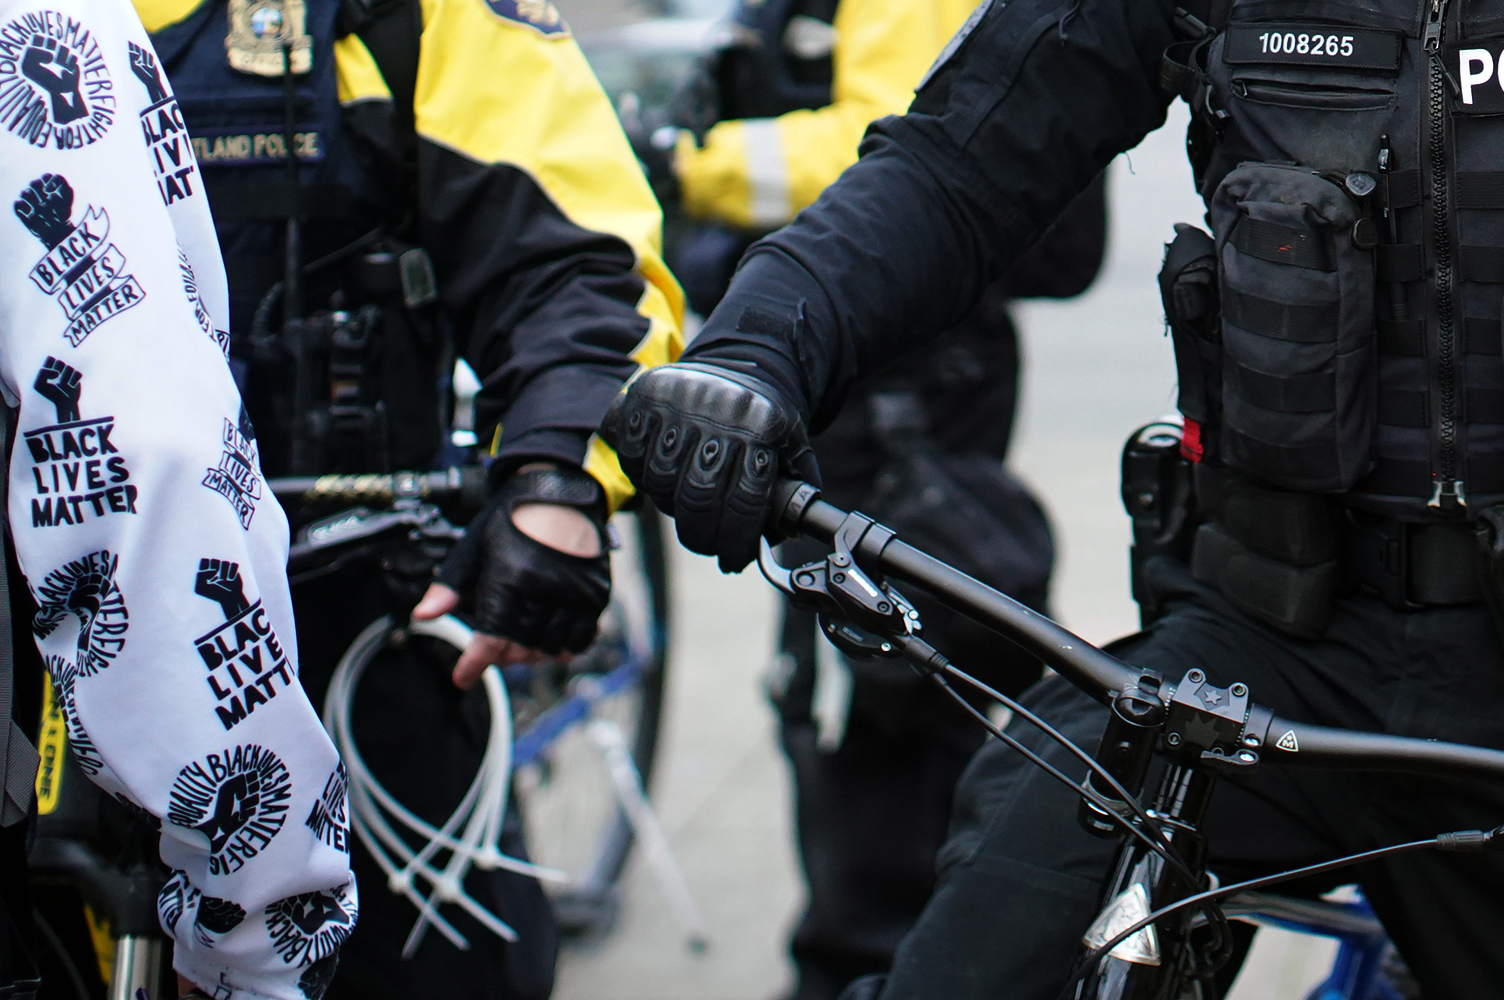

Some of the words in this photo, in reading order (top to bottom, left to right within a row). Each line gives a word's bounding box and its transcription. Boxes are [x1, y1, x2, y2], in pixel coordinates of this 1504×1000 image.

[1259, 33, 1354, 57] 1008265
[190, 135, 252, 160] TLAND
[254, 132, 321, 158] POLCE
[36, 221, 101, 287] BLACK
[64, 256, 115, 310] LIVES
[71, 284, 139, 341] MATTER
[26, 424, 119, 463] BLACK
[32, 456, 130, 494] LIVES
[225, 454, 257, 493] LIVES
[31, 484, 138, 528] MATTER
[208, 472, 249, 524] MATTER
[197, 607, 271, 672] BLAC
[206, 630, 284, 702] LIVE
[215, 657, 292, 731] MATT
[206, 743, 262, 784] BLACK
[230, 783, 293, 859] MATTER
[209, 847, 246, 876] FIG
